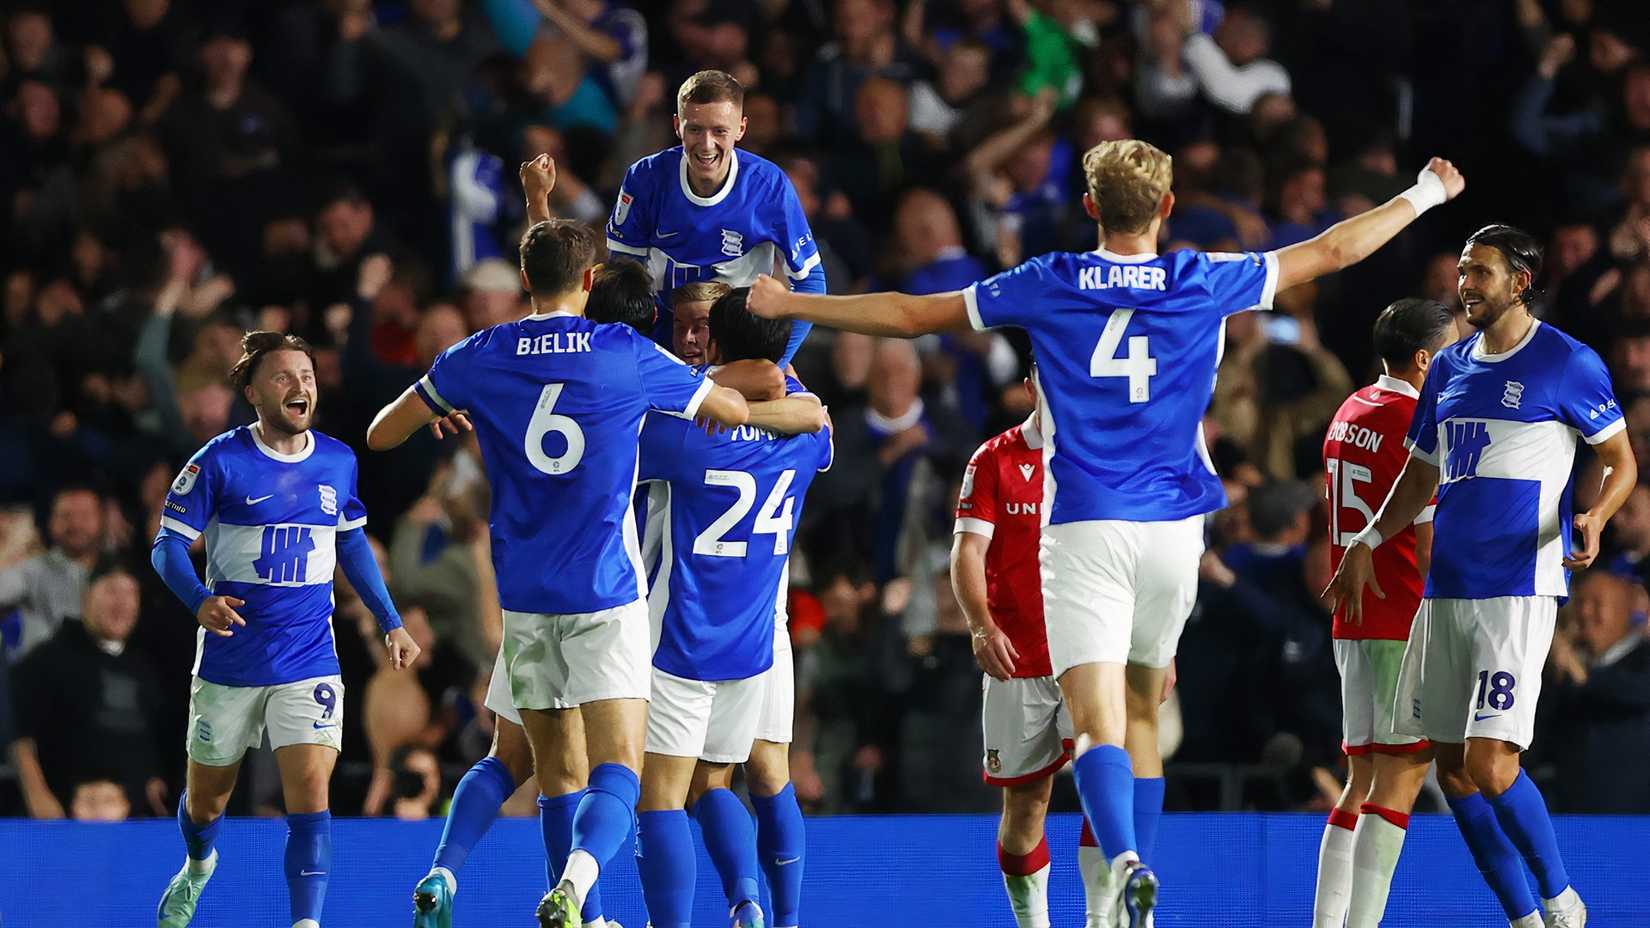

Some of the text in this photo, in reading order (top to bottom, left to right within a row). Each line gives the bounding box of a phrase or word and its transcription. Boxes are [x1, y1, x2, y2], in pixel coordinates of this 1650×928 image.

[1079, 265, 1166, 291] KLARER
[516, 332, 592, 355] BIELIK
[1090, 308, 1157, 403] 4
[525, 383, 585, 475] 6
[693, 469, 797, 557] 24
[1327, 458, 1376, 547] 15
[313, 682, 337, 720] 9
[1476, 670, 1516, 711] 18
